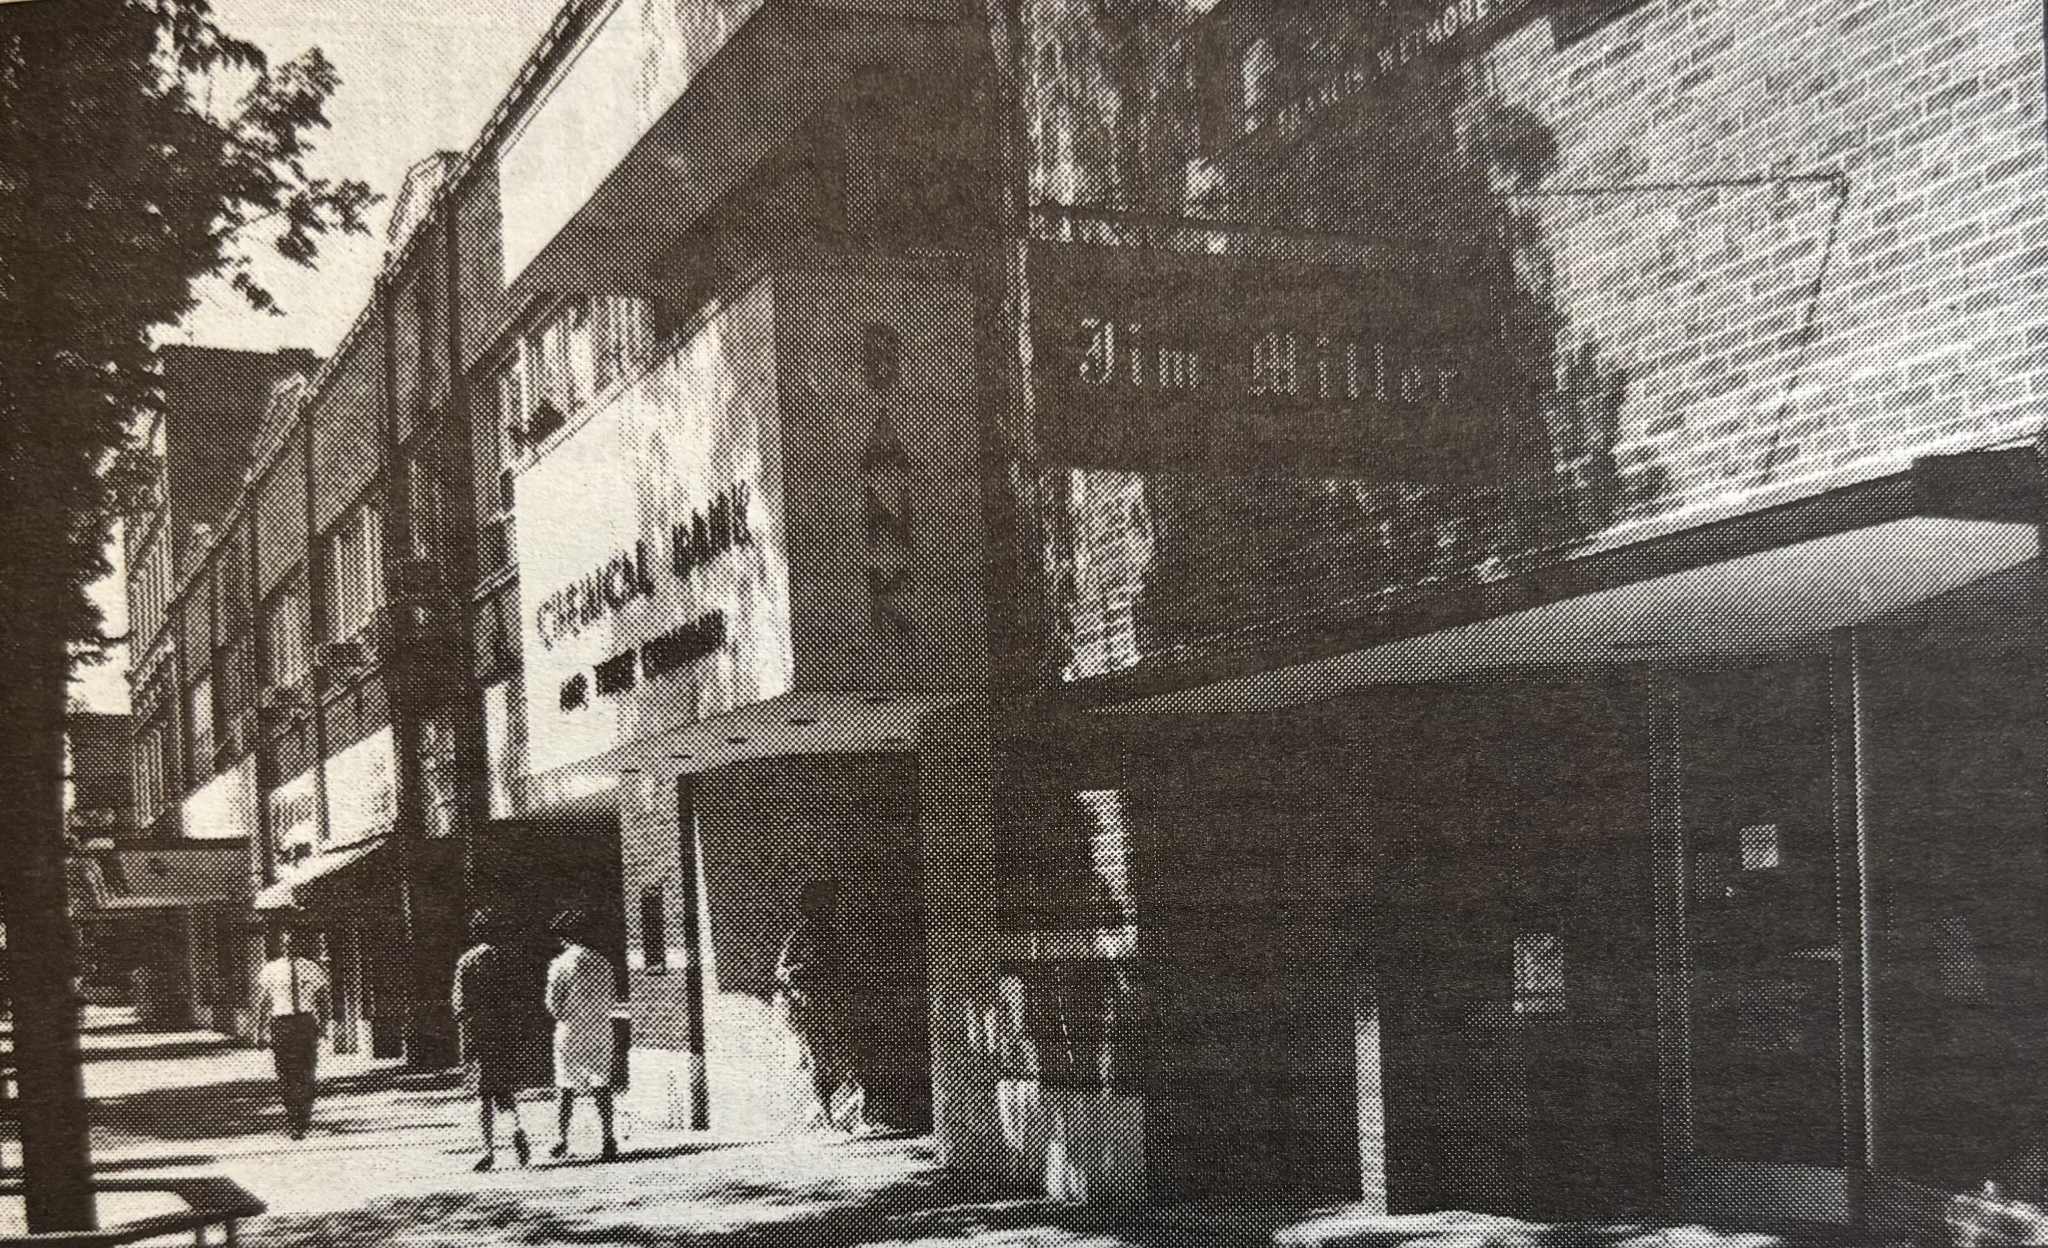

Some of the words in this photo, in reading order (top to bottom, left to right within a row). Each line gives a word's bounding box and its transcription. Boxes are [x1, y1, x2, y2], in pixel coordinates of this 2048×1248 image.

[1078, 317, 1201, 389] Jim
[1248, 331, 1458, 403] Miller
[537, 538, 654, 649] CHEMICAL
[671, 480, 750, 579] BANK
[861, 321, 916, 642] BANK
